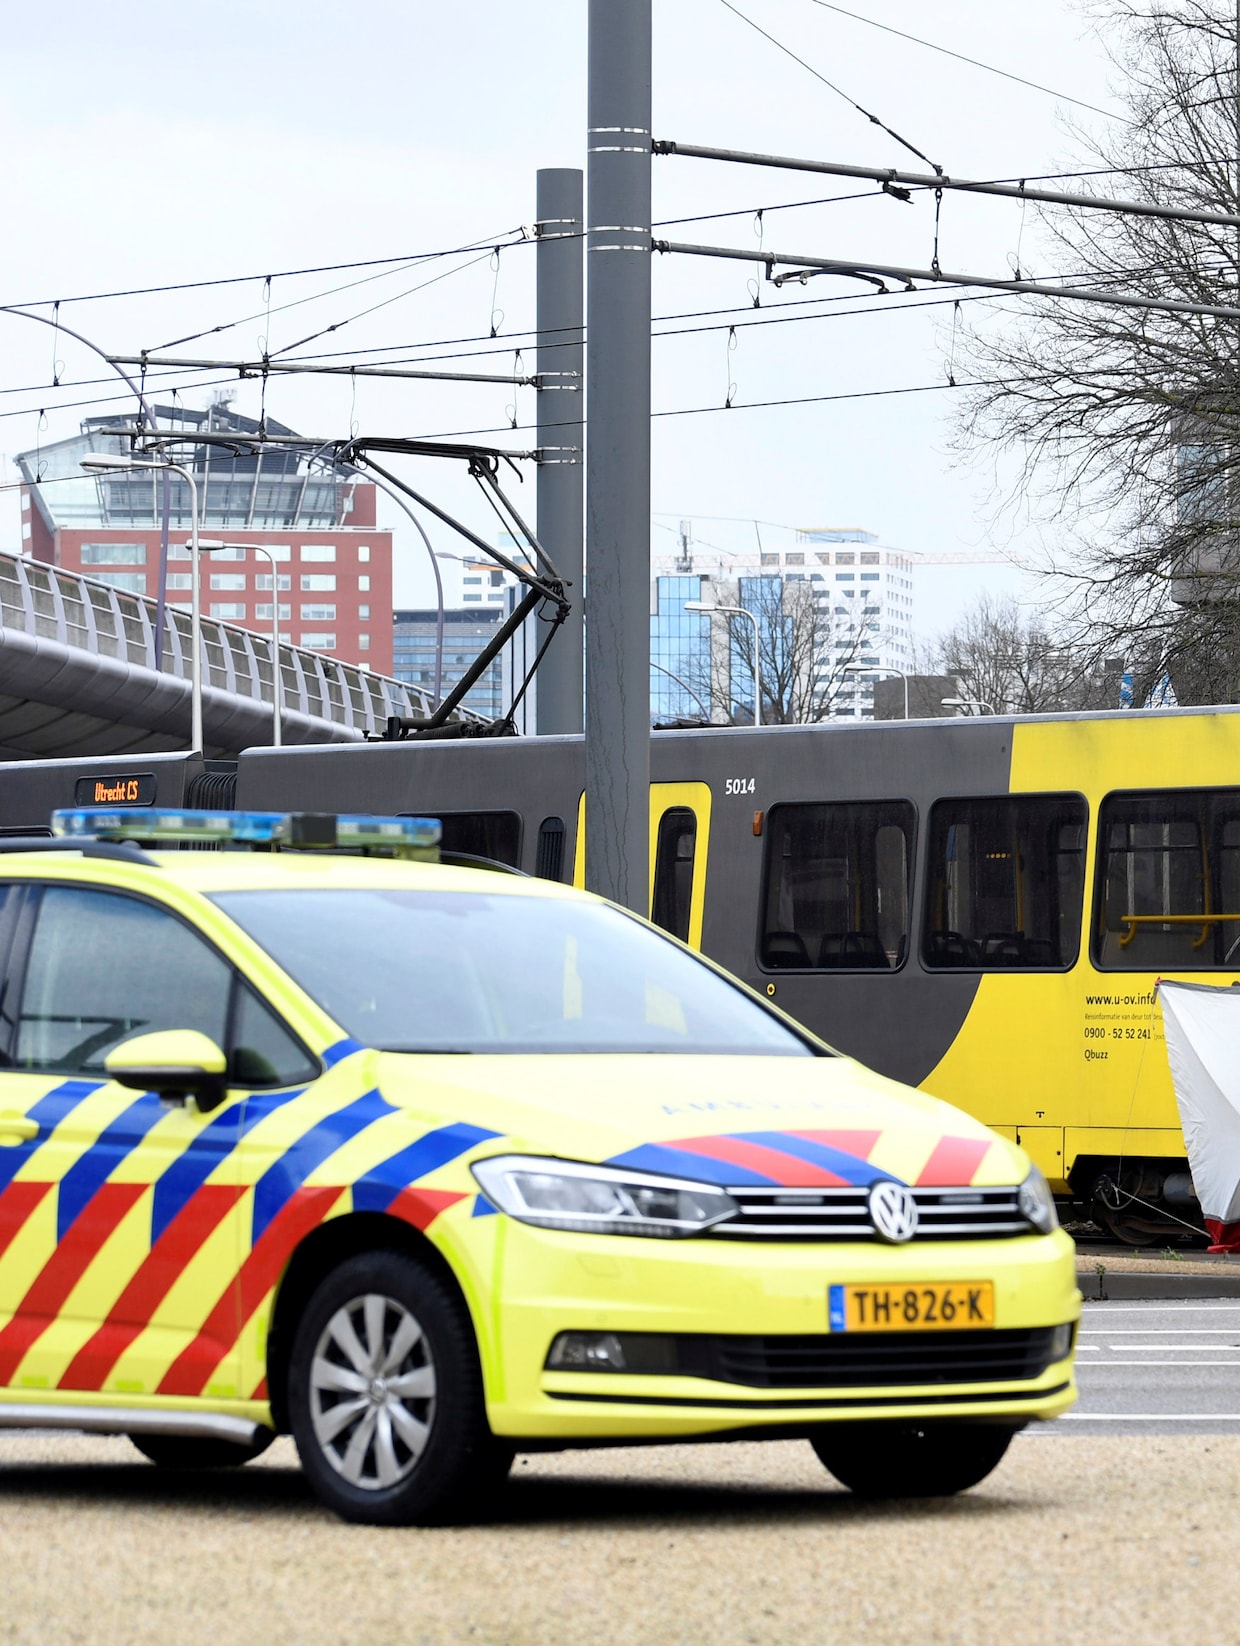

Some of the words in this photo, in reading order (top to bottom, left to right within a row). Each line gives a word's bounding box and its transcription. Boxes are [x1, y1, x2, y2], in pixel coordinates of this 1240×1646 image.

[94, 781, 126, 802] Utrecht
[127, 780, 139, 800] CS
[725, 778, 756, 795] 5014
[1084, 1027, 1106, 1039] 0900
[1113, 1028, 1123, 1039] 52
[1125, 1028, 1136, 1039] 52
[1137, 1028, 1151, 1040] 241
[1084, 1049, 1109, 1062] Qbuzz
[853, 1288, 984, 1324] TH-826-K
